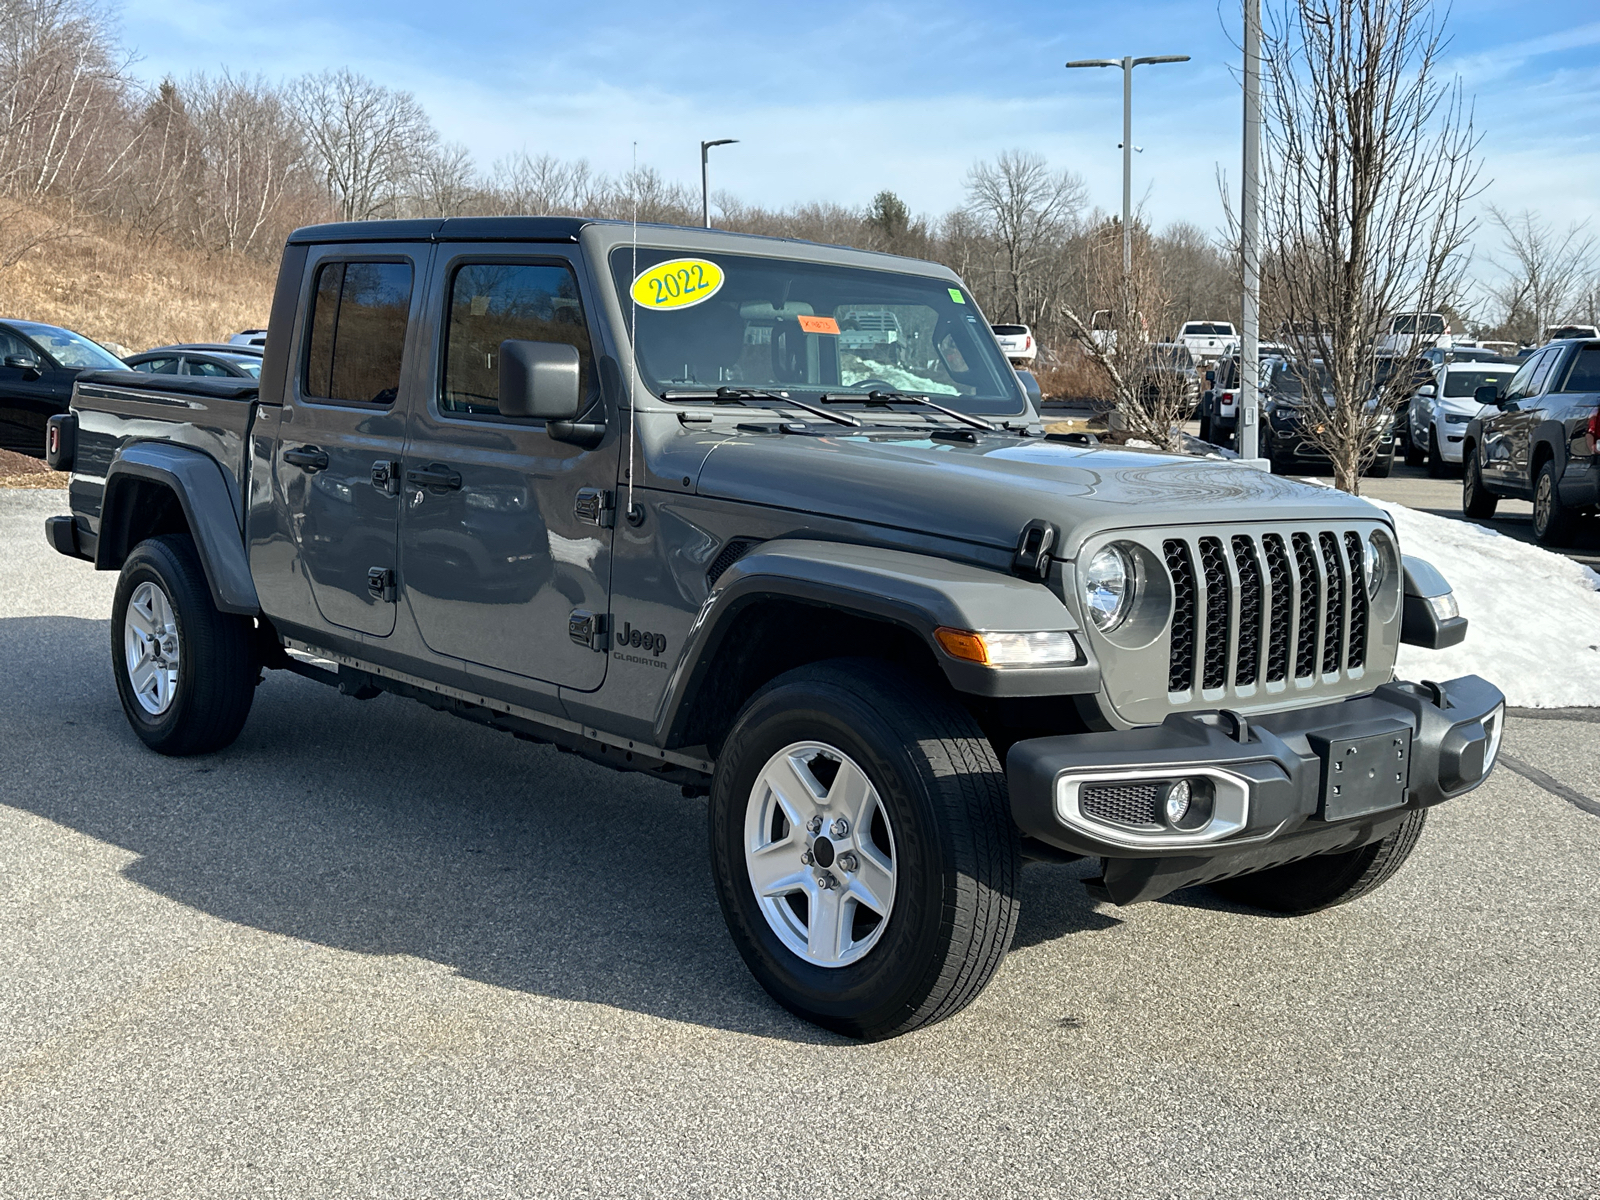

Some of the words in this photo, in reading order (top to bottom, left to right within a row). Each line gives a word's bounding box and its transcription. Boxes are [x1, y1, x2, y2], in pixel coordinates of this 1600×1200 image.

[648, 264, 709, 304] 2022
[616, 621, 667, 657] Jeep
[613, 651, 668, 670] GLADIATOR
